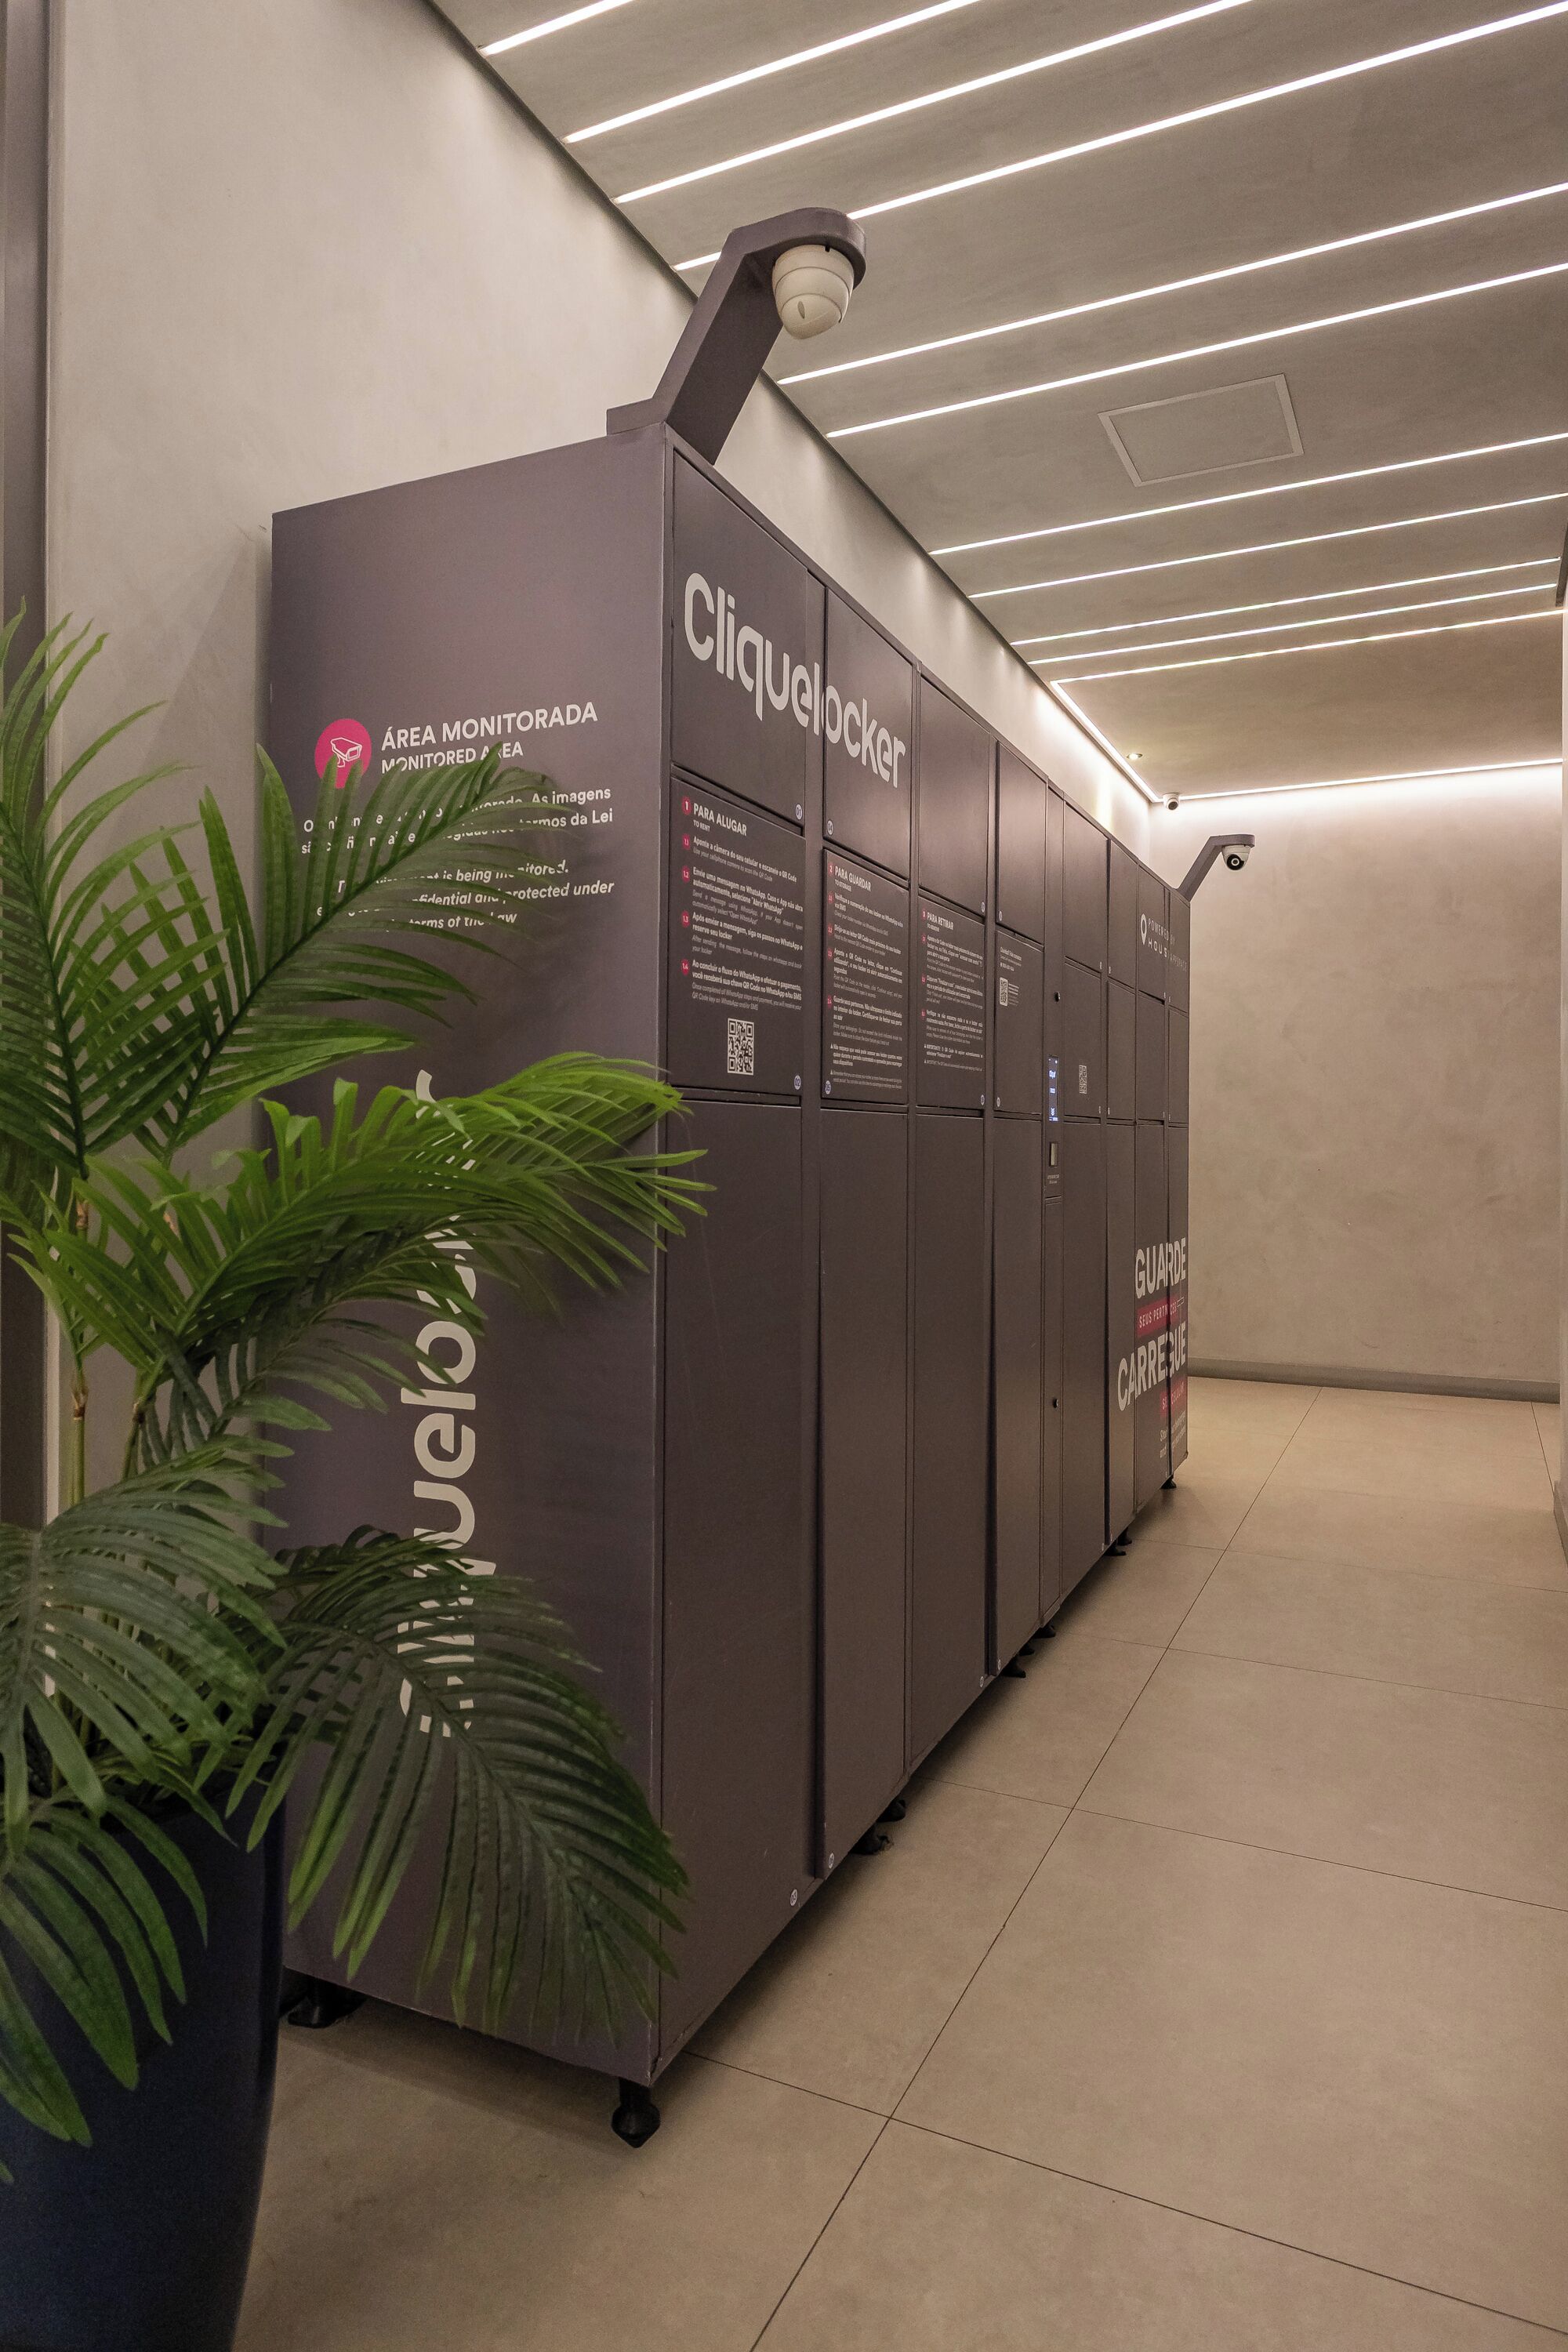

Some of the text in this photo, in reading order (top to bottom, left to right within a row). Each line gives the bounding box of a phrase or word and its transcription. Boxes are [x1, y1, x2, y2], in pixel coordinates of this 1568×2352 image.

[684, 572, 906, 788] Cliquelocker
[381, 702, 598, 751] ÁREA MONITORADA
[480, 741, 524, 761] AEA
[552, 787, 612, 805] imagens
[570, 811, 588, 826] da
[592, 808, 613, 823] Lei
[685, 800, 746, 837] 1 PARA ALUGAR
[693, 819, 710, 832] TO RENT
[694, 836, 709, 850] Aponte
[714, 843, 729, 857] câmera
[745, 856, 758, 868] celular
[762, 862, 778, 876] escaneie
[782, 870, 787, 879] QR
[788, 873, 797, 883] Code
[456, 869, 492, 883] being
[835, 866, 848, 880] PARA
[849, 872, 871, 891] GUARDAR
[574, 880, 615, 896] under
[693, 924, 710, 934] reserve
[719, 931, 731, 940] locker
[1148, 918, 1169, 941] POWERED
[1135, 1237, 1186, 1299] GUARDE
[1139, 1311, 1152, 1329] SEUS
[1117, 1321, 1186, 1411] CARREGUE
